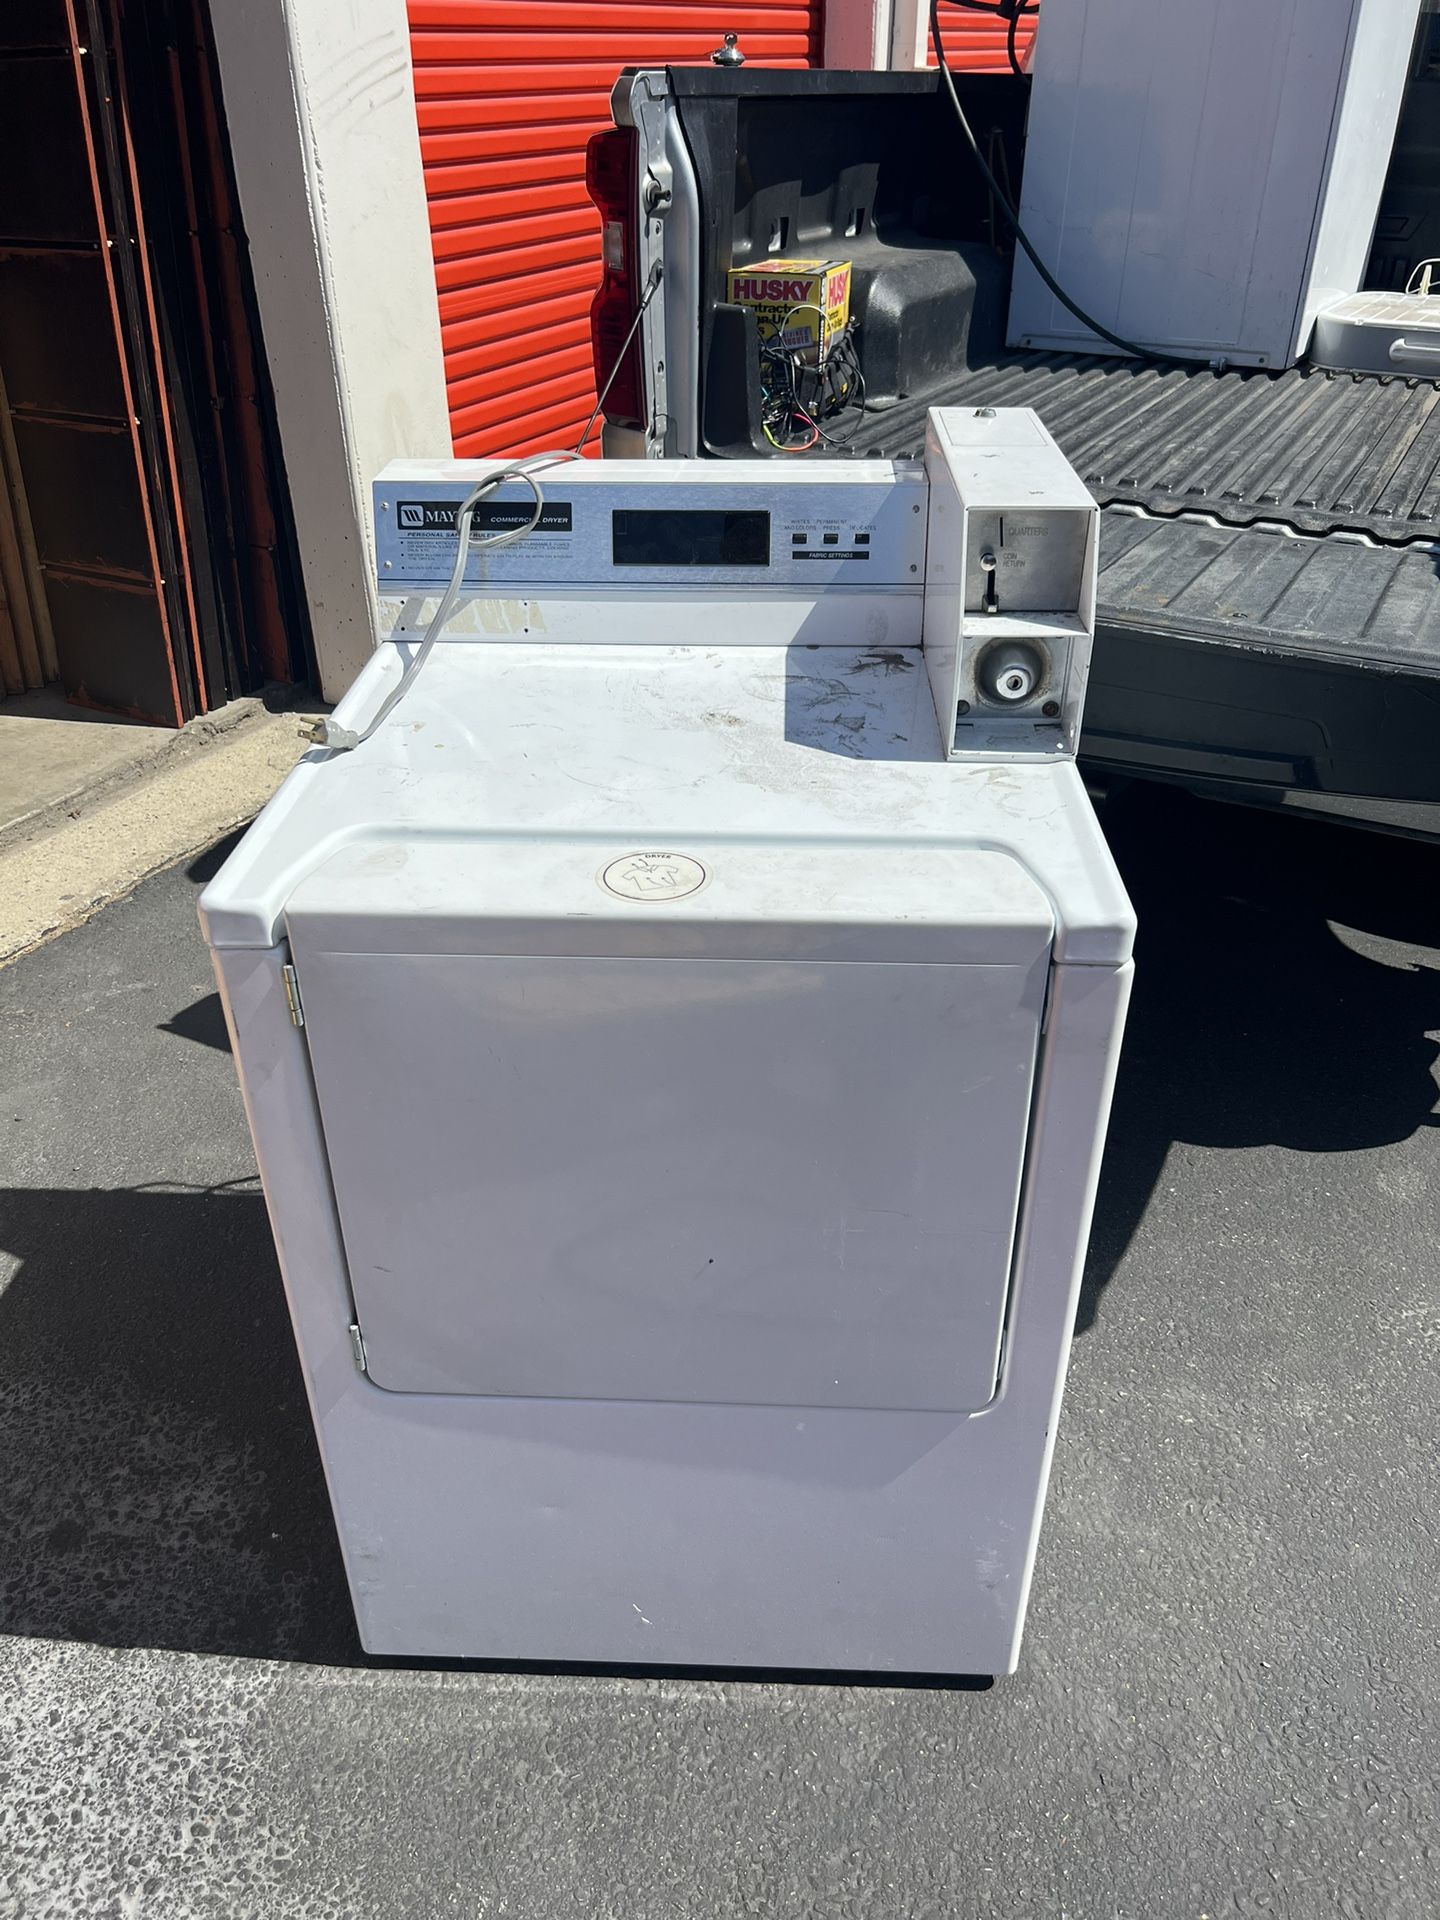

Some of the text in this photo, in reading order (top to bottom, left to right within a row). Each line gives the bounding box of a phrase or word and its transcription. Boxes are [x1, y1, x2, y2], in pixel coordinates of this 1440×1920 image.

[733, 278, 814, 302] HUSKY
[426, 511, 481, 522] MAYG
[1009, 527, 1048, 536] QUARTERS
